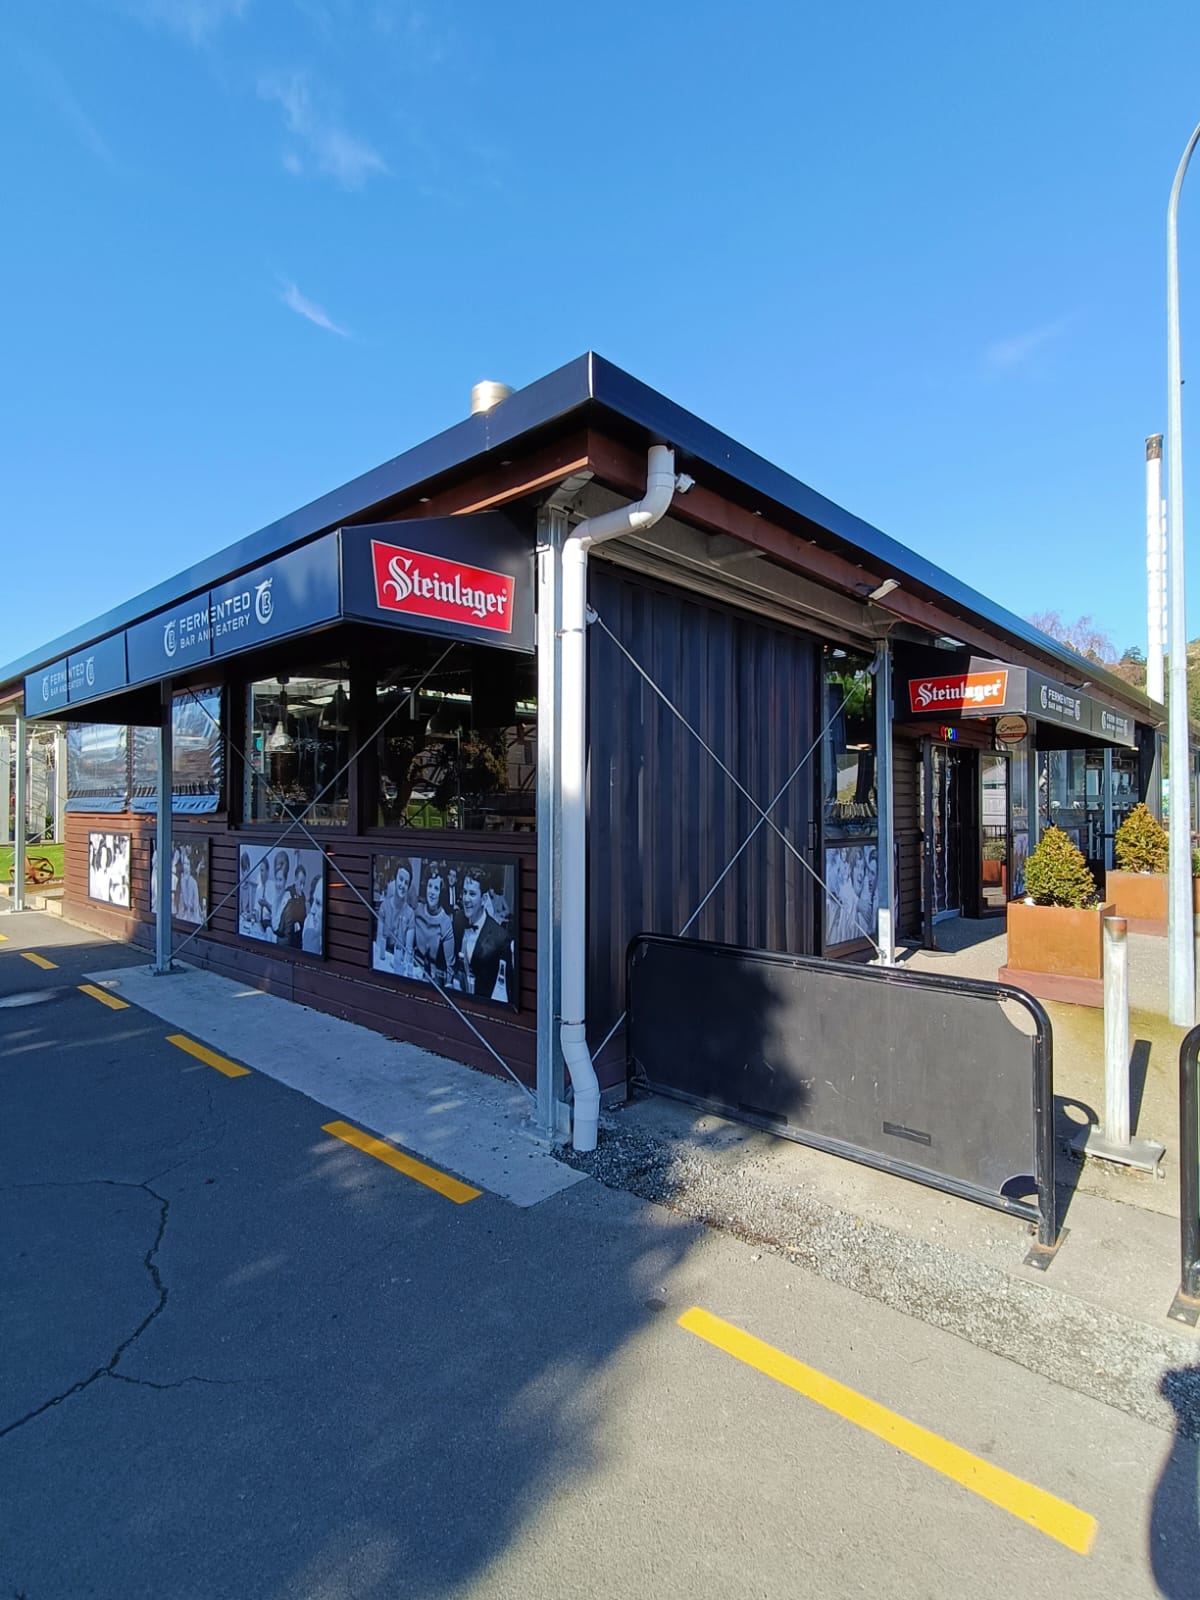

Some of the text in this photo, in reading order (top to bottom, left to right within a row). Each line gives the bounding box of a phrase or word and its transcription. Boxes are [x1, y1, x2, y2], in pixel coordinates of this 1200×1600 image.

[383, 555, 508, 618] Steinlager
[179, 592, 251, 634] FERMENTED
[180, 634, 196, 649] BAR
[216, 613, 251, 637] EATERY
[914, 679, 1002, 707] Steinlager
